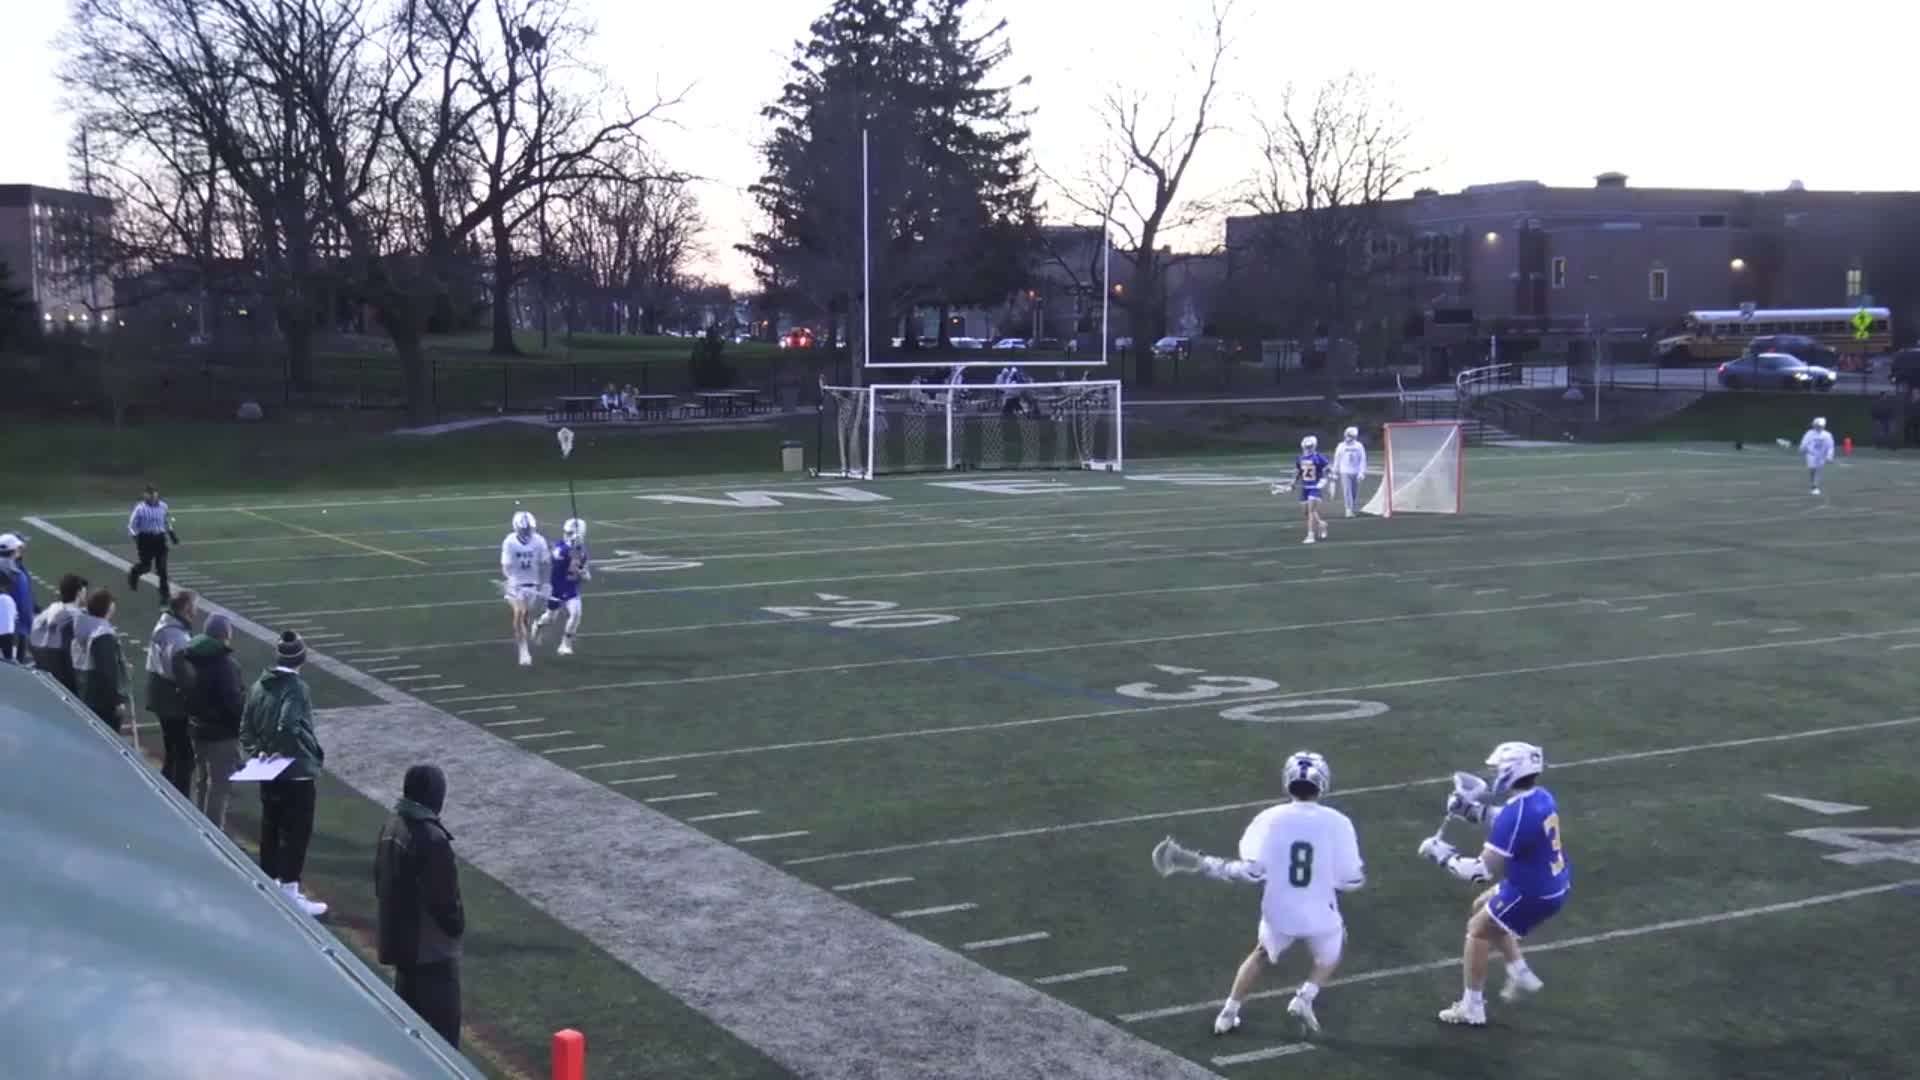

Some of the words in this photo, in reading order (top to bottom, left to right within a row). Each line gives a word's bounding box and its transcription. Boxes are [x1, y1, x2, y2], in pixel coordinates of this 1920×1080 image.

[760, 600, 961, 628] 20
[1115, 675, 1391, 722] 30
[1288, 841, 1314, 888] 8
